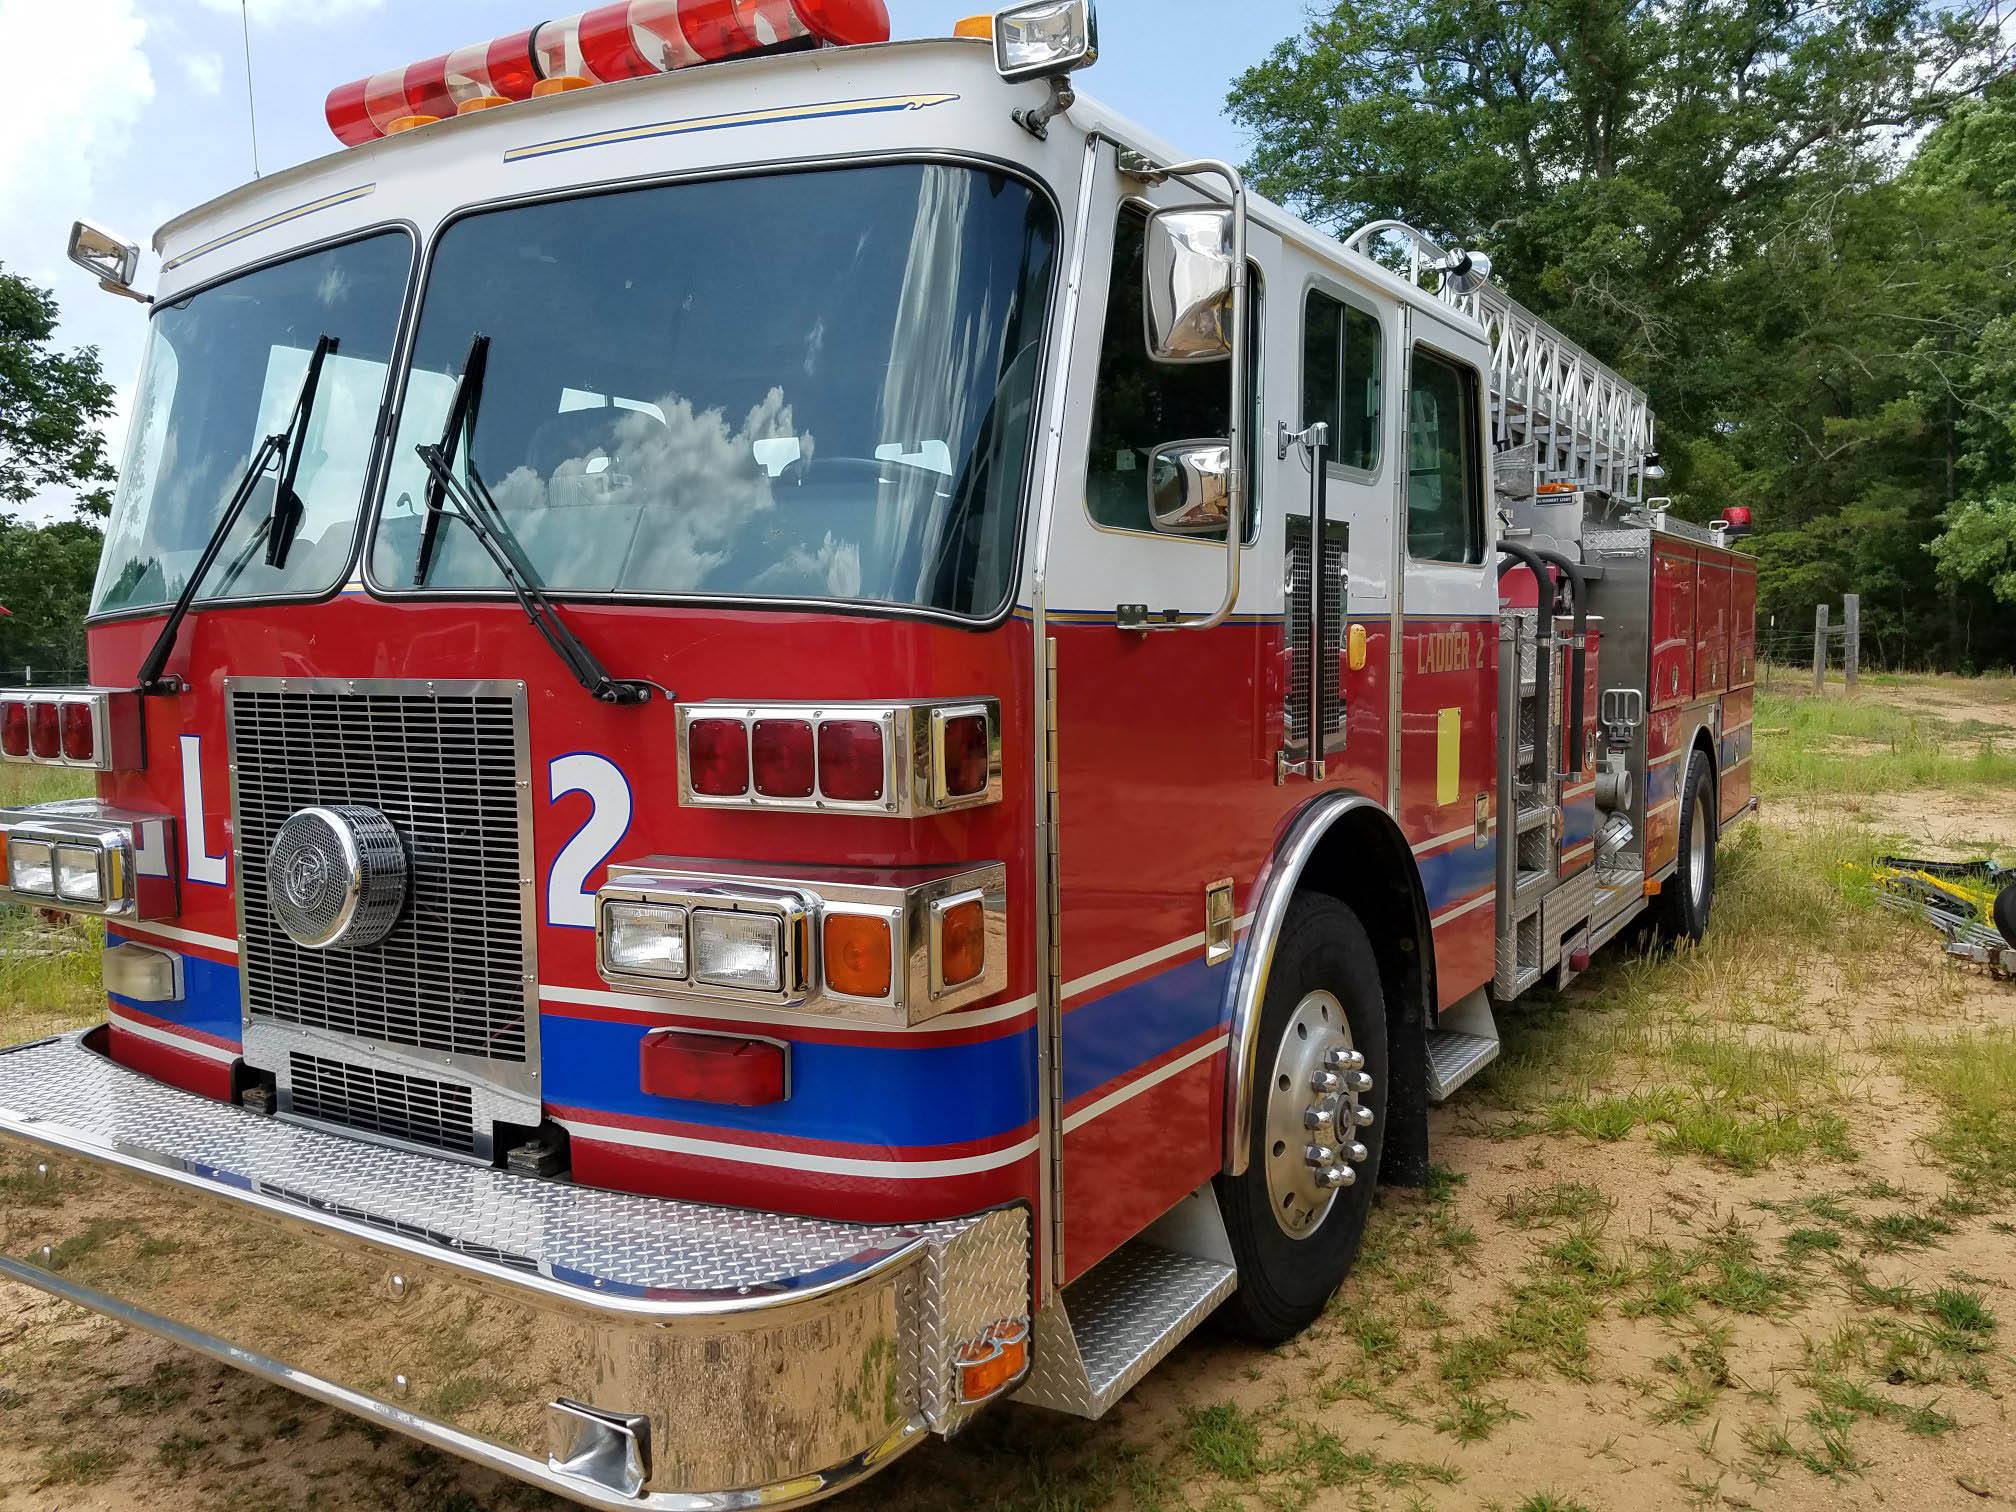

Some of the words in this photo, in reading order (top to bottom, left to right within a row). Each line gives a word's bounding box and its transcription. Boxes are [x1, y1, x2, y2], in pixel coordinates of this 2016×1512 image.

[1417, 632, 1470, 675] LADDER
[1475, 632, 1485, 669] 2
[179, 734, 227, 888] L
[547, 752, 634, 930] 2
